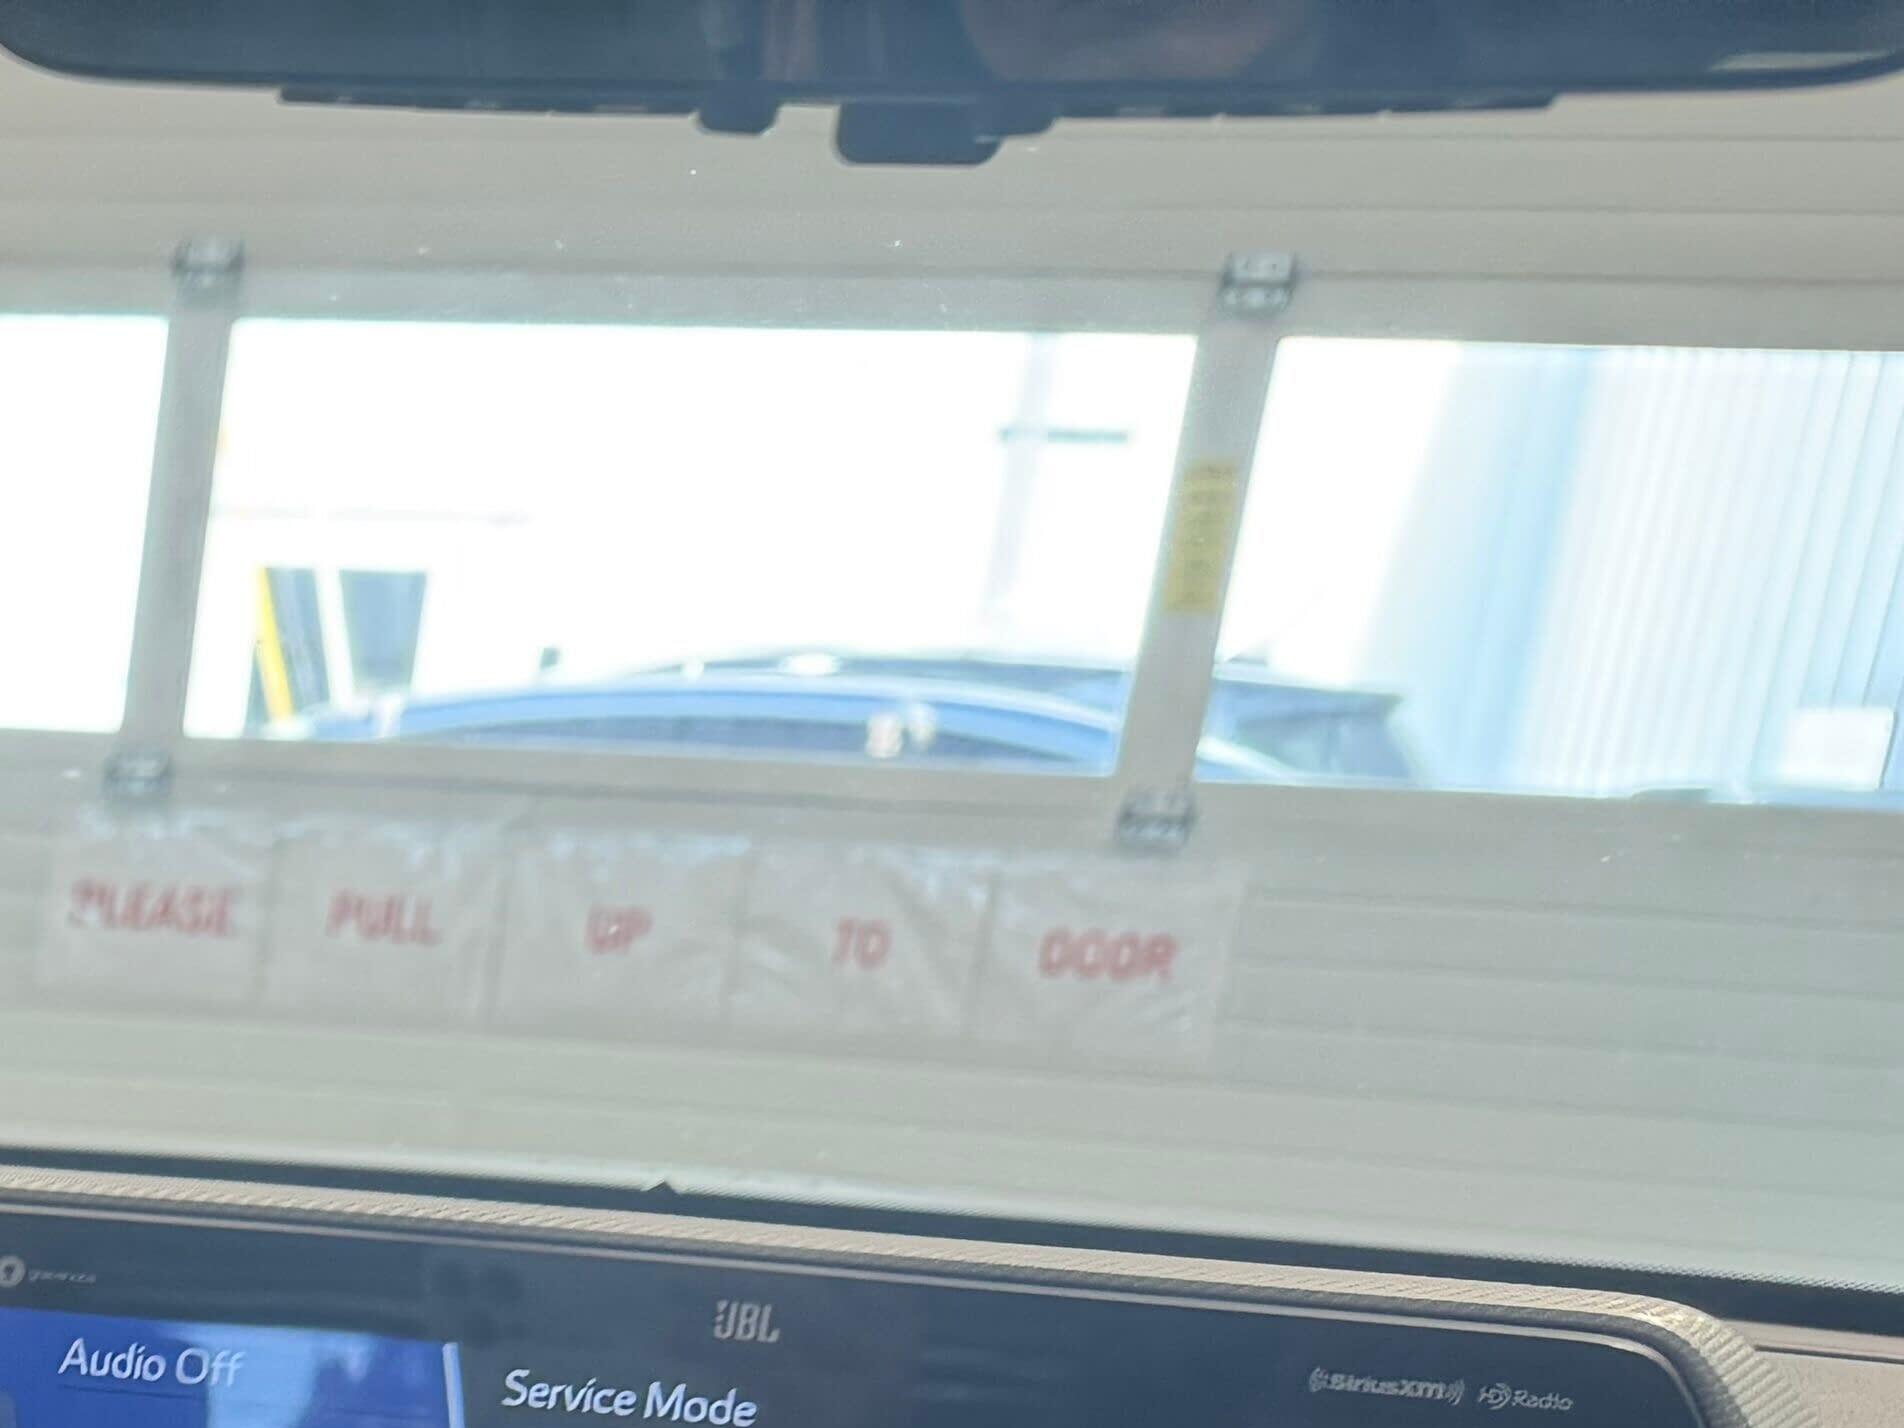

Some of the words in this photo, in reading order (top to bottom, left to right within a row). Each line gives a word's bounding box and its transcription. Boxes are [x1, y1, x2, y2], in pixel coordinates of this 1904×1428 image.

[68, 879, 238, 938] PLEASE
[326, 888, 441, 947] PULL
[584, 905, 655, 955] UP
[832, 916, 889, 970] TO
[1038, 925, 1178, 982] DOOR
[712, 1299, 781, 1344] JBL
[57, 1336, 166, 1384] Audio
[175, 1346, 245, 1388] Off
[501, 1368, 637, 1417] Service
[643, 1380, 760, 1428] Mode
[1512, 1390, 1574, 1411] Radio
